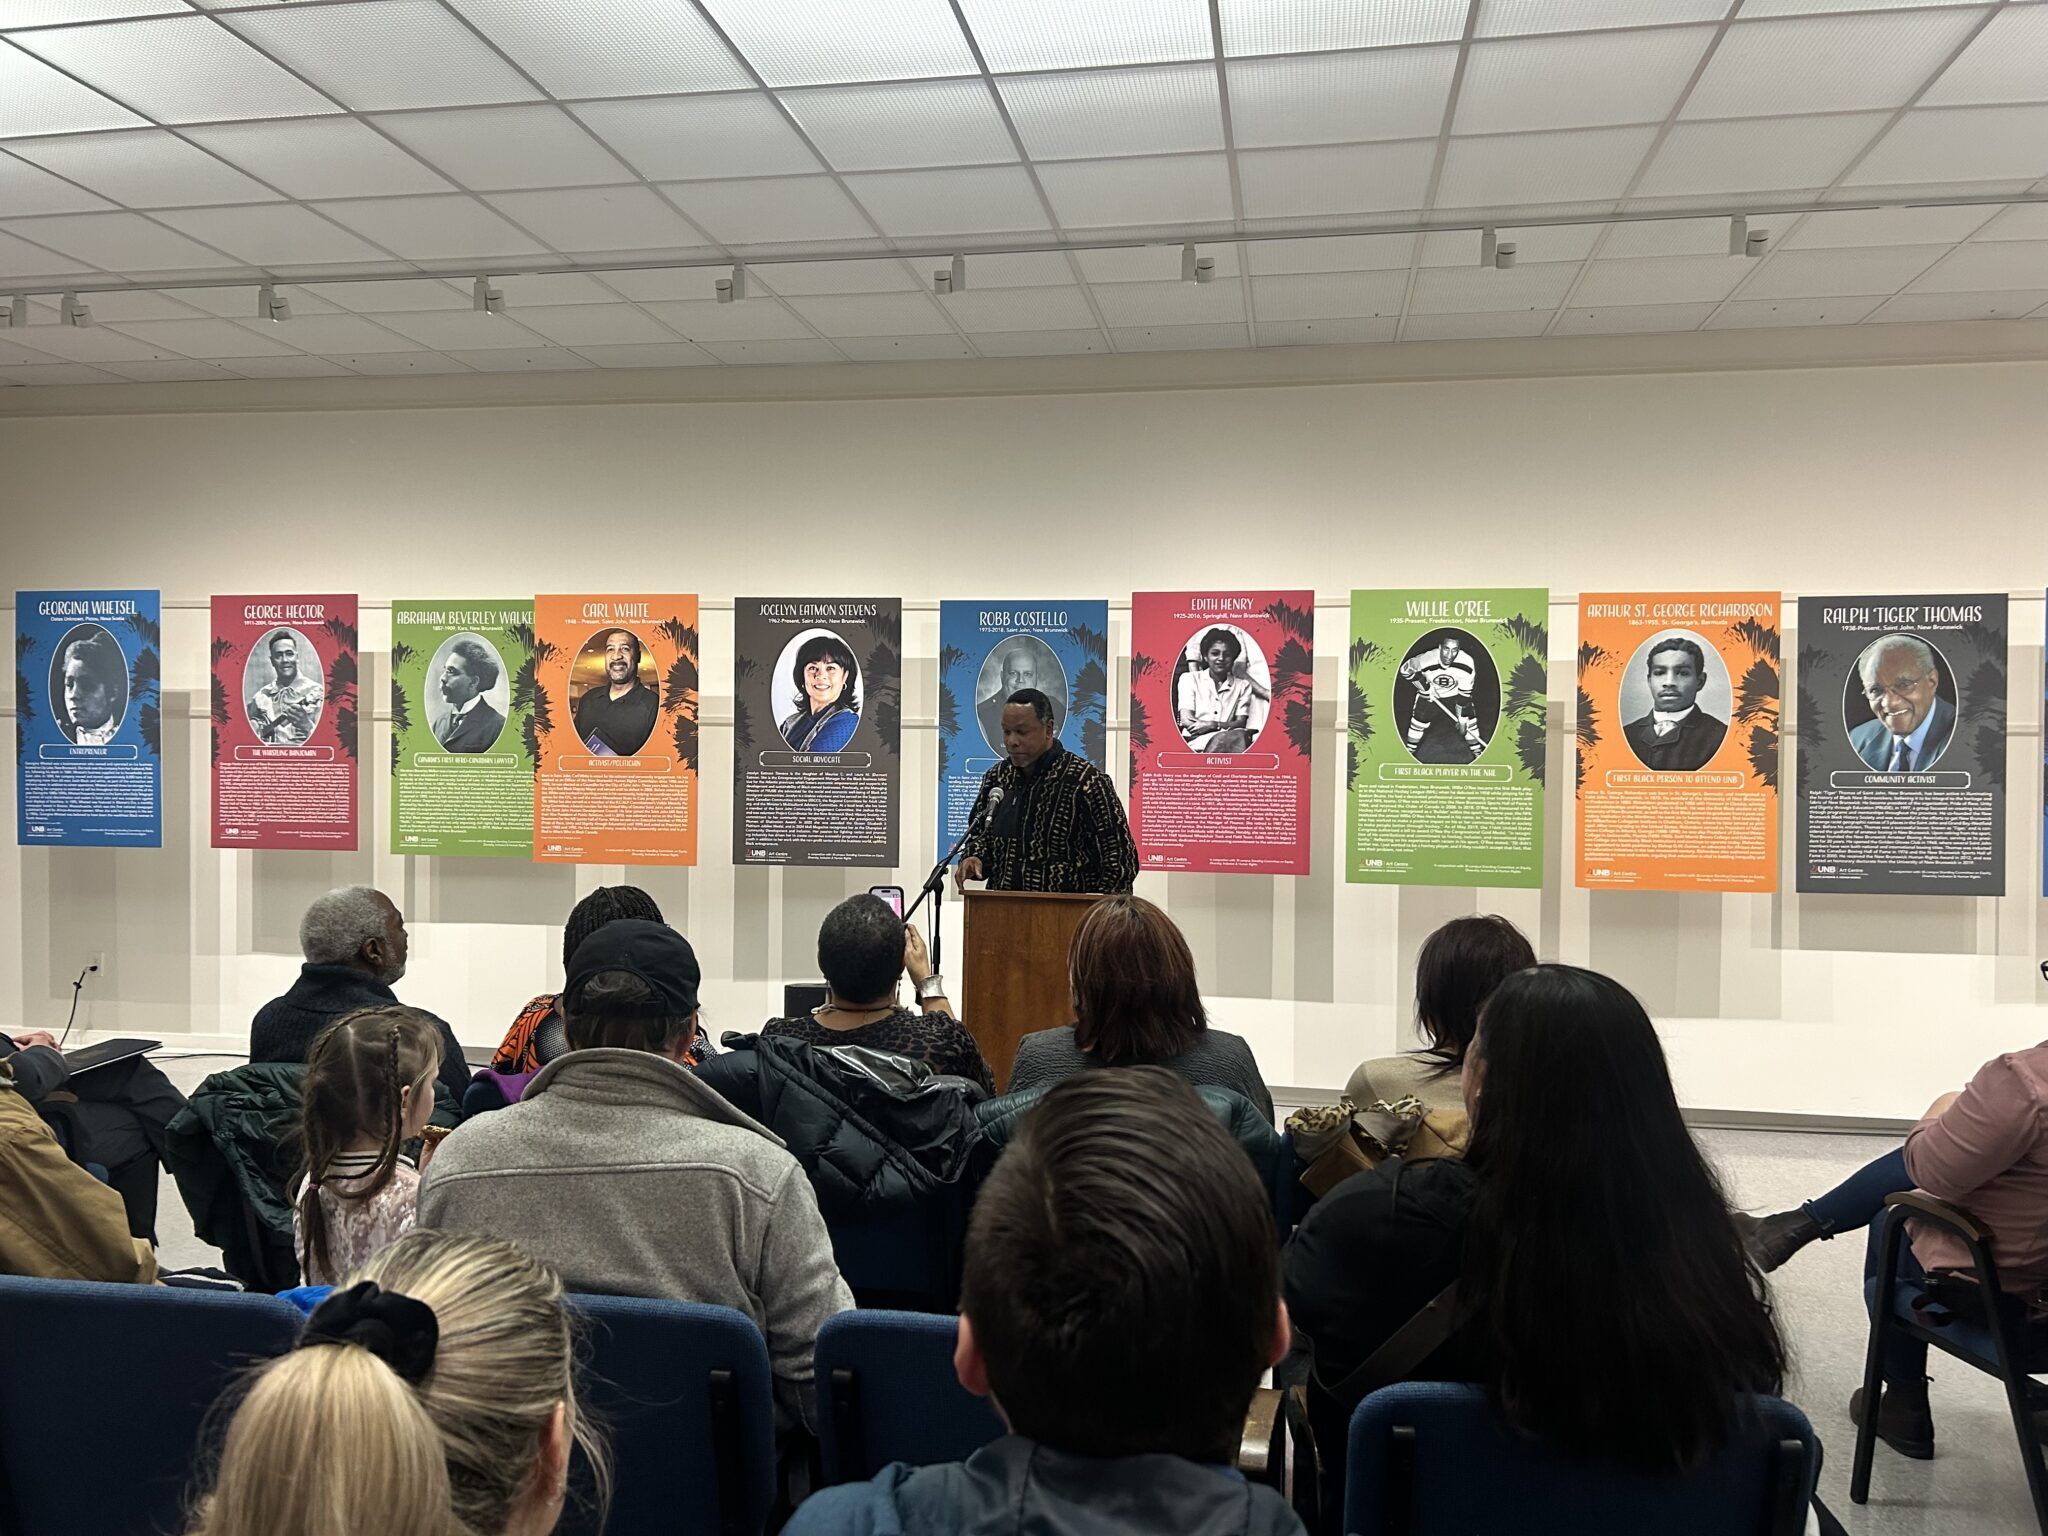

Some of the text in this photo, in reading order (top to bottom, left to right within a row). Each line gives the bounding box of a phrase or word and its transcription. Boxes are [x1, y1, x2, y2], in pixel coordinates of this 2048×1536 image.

[38, 601, 137, 615] GEORGINA WHETSEL
[583, 603, 650, 618] CARL WHITE
[760, 604, 877, 616] JOCELYN EATMON STEVENS
[1191, 598, 1254, 611] EDITH HENRY
[1406, 601, 1492, 617] WILLIE O'REE
[1587, 604, 1773, 618] ARTHUR ST. GEORGE RICHARDSON
[244, 605, 325, 619] GEORGE HECTOR
[397, 611, 536, 625] ABRAHAM BEVERLEY WALKE
[980, 612, 1068, 626] ROBB COSTELLO
[1823, 608, 1869, 624] RALPH
[1922, 606, 1982, 623] THOMAS
[1206, 757, 1232, 765] ACTIVIST
[1394, 767, 1412, 776] FIRST
[1413, 767, 1433, 776] BLACK
[1435, 767, 1459, 776] PLAYER
[1460, 767, 1468, 776] IN
[1484, 769, 1497, 777] NHL
[1613, 774, 1738, 784] FIRST BLACK PERSON TO ATTEND UNB
[1864, 776, 1937, 784] COMMUNITY ACTIVIST
[1365, 859, 1383, 867] UNB
